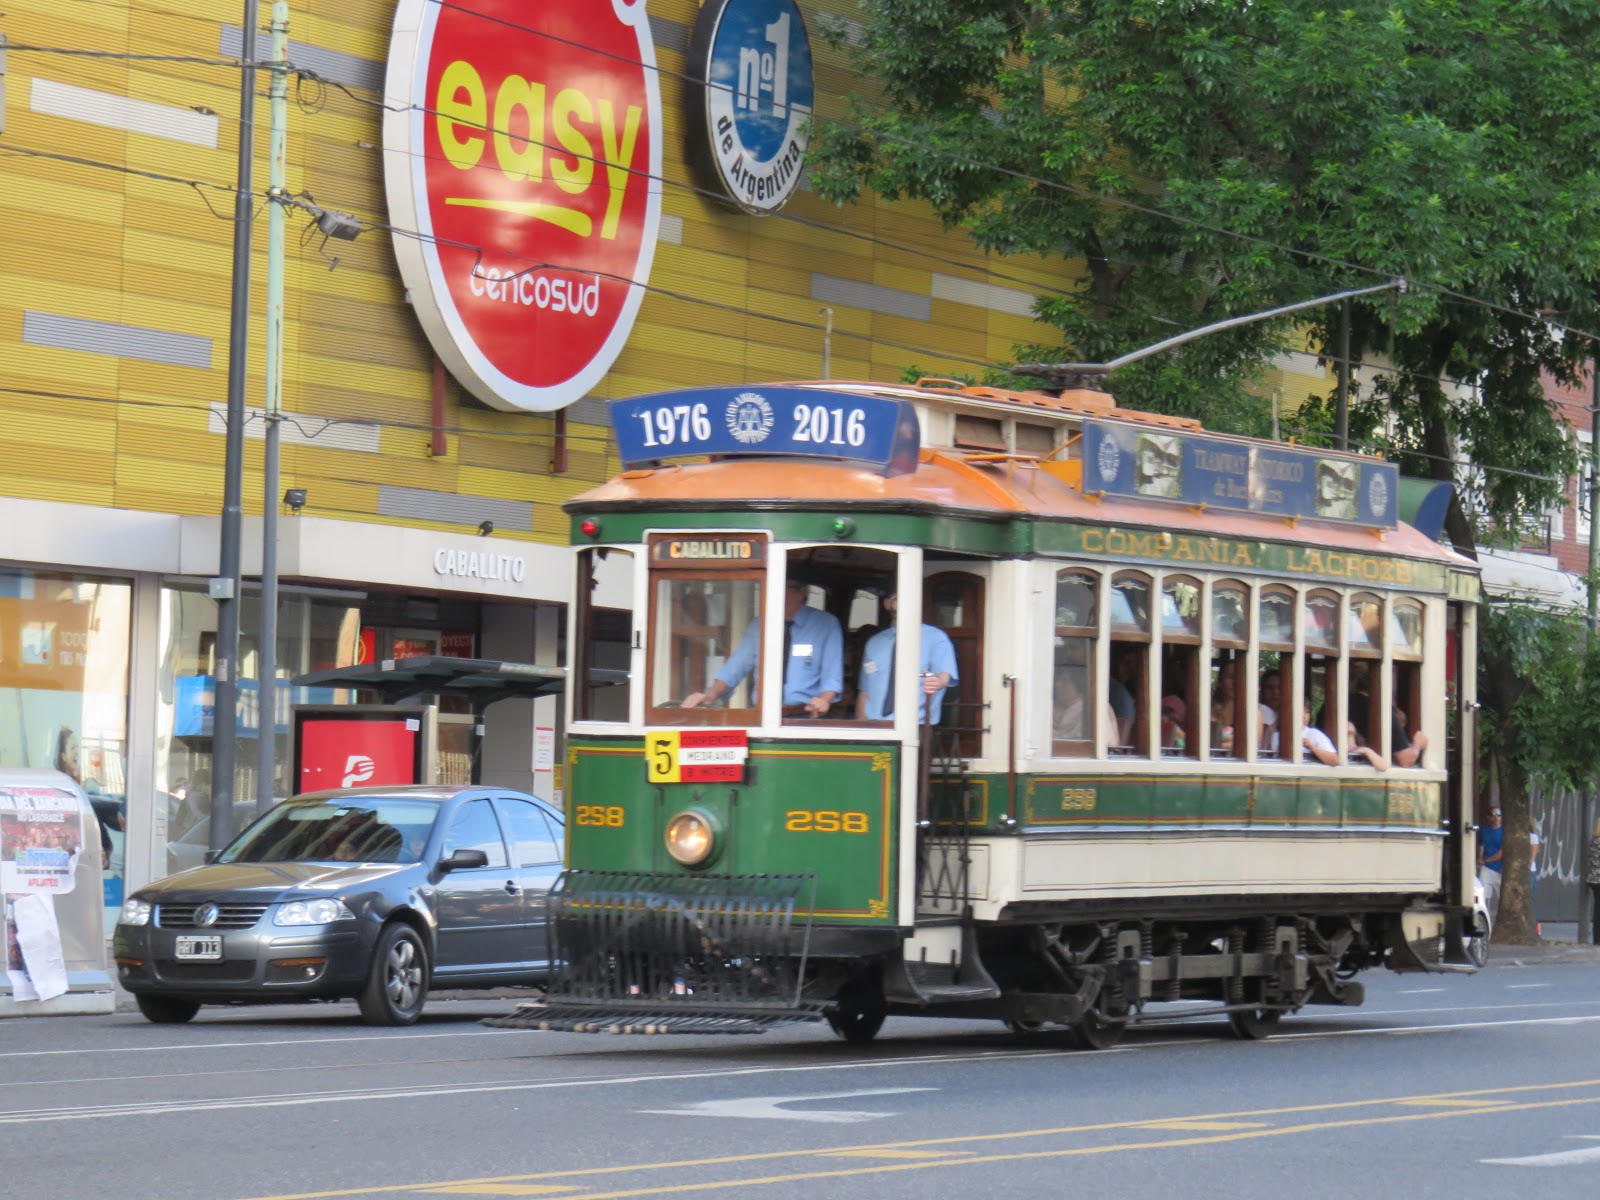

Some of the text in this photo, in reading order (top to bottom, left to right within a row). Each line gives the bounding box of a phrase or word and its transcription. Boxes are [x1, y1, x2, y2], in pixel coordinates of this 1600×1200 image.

[436, 60, 643, 240] easy
[717, 115, 800, 201] de Argentina
[470, 264, 600, 317] cencosud
[638, 403, 712, 447] 1976
[792, 404, 866, 447] 2016
[669, 541, 751, 559] CABALLITO
[433, 547, 526, 584] CABALLITO
[1286, 549, 1413, 584] LACROZE
[681, 735, 741, 747] CORRIENTES
[656, 739, 672, 775] 5
[702, 766, 736, 778] MITRE
[1062, 789, 1097, 810] 258
[576, 805, 624, 827] 258
[785, 810, 868, 834] 258
[201, 941, 219, 955] 113
